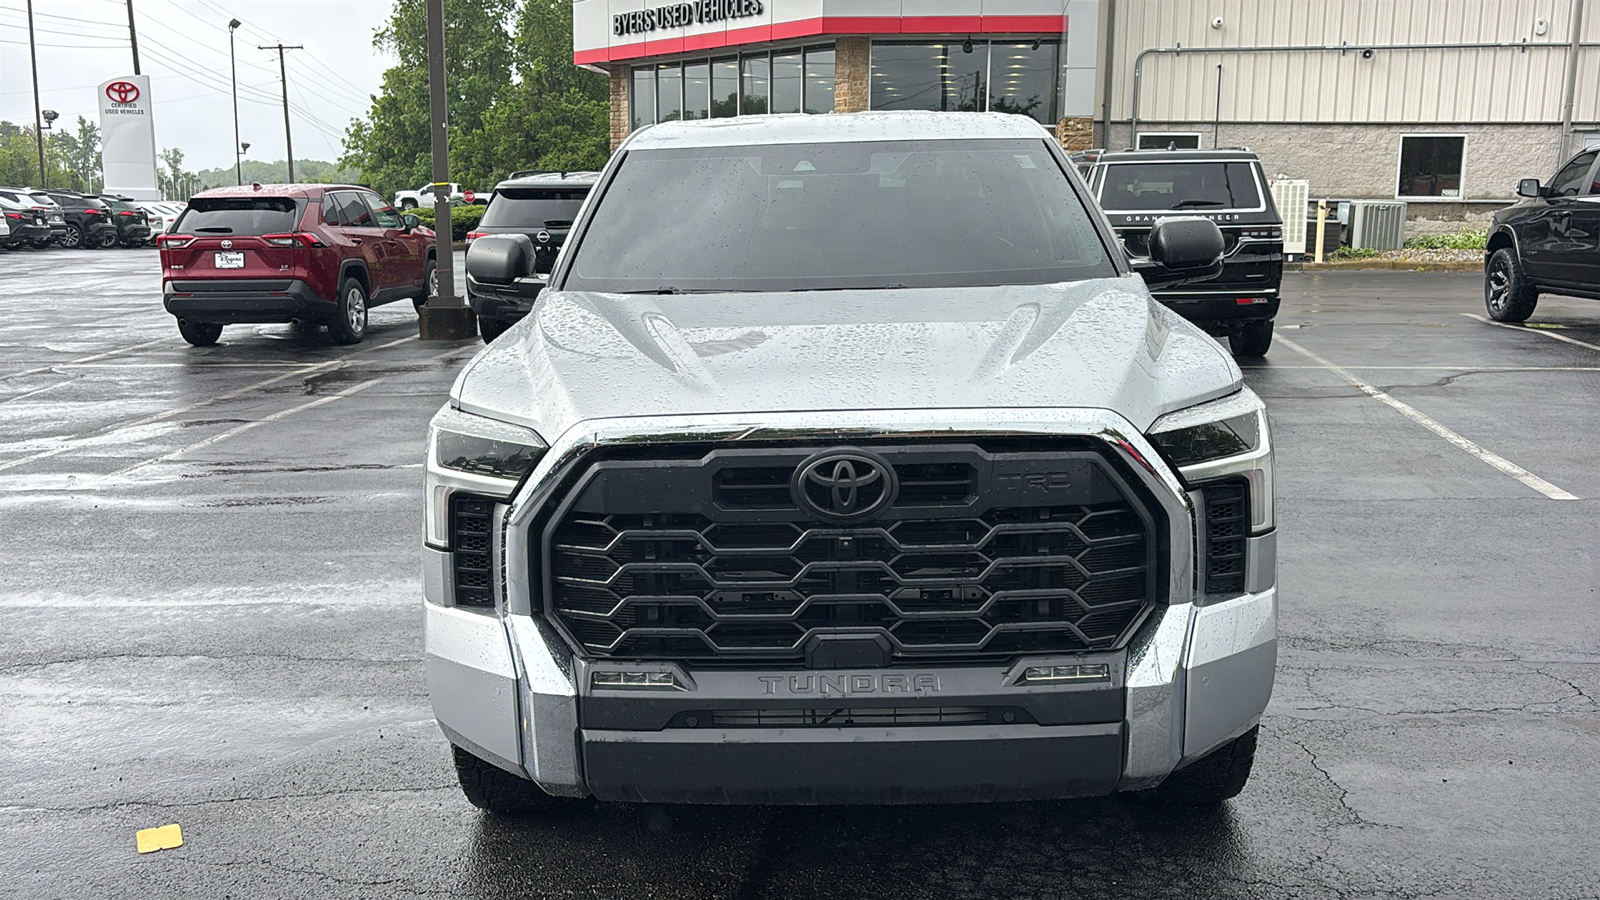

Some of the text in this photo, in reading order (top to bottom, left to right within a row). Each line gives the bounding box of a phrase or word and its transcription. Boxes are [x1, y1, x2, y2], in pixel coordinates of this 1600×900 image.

[613, 0, 761, 35] BYERS USED VEHICLES
[999, 472, 1070, 493] TRD
[757, 673, 941, 695] TUNDRA
